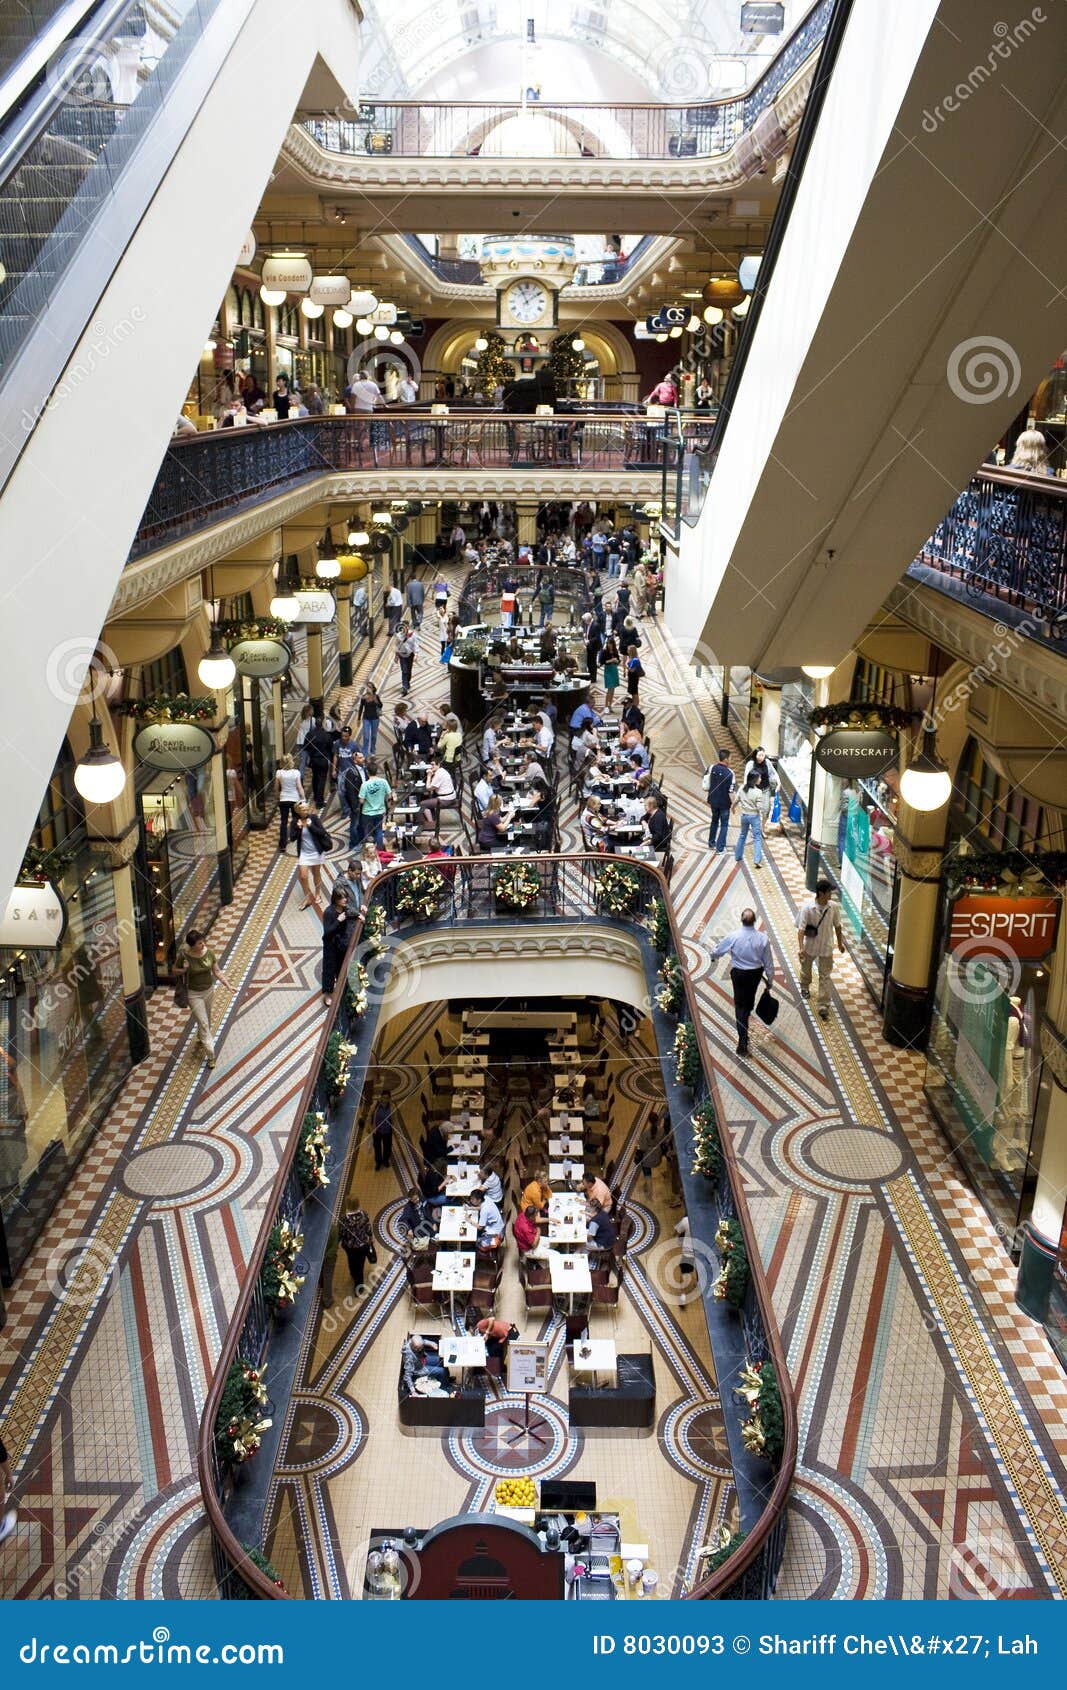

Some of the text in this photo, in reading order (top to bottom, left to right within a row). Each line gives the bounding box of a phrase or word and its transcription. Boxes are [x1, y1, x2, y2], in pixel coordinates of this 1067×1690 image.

[279, 273, 308, 282] Condotti
[821, 748, 895, 756] SPORTSCRAFT
[950, 912, 1056, 938] ESPRIT
